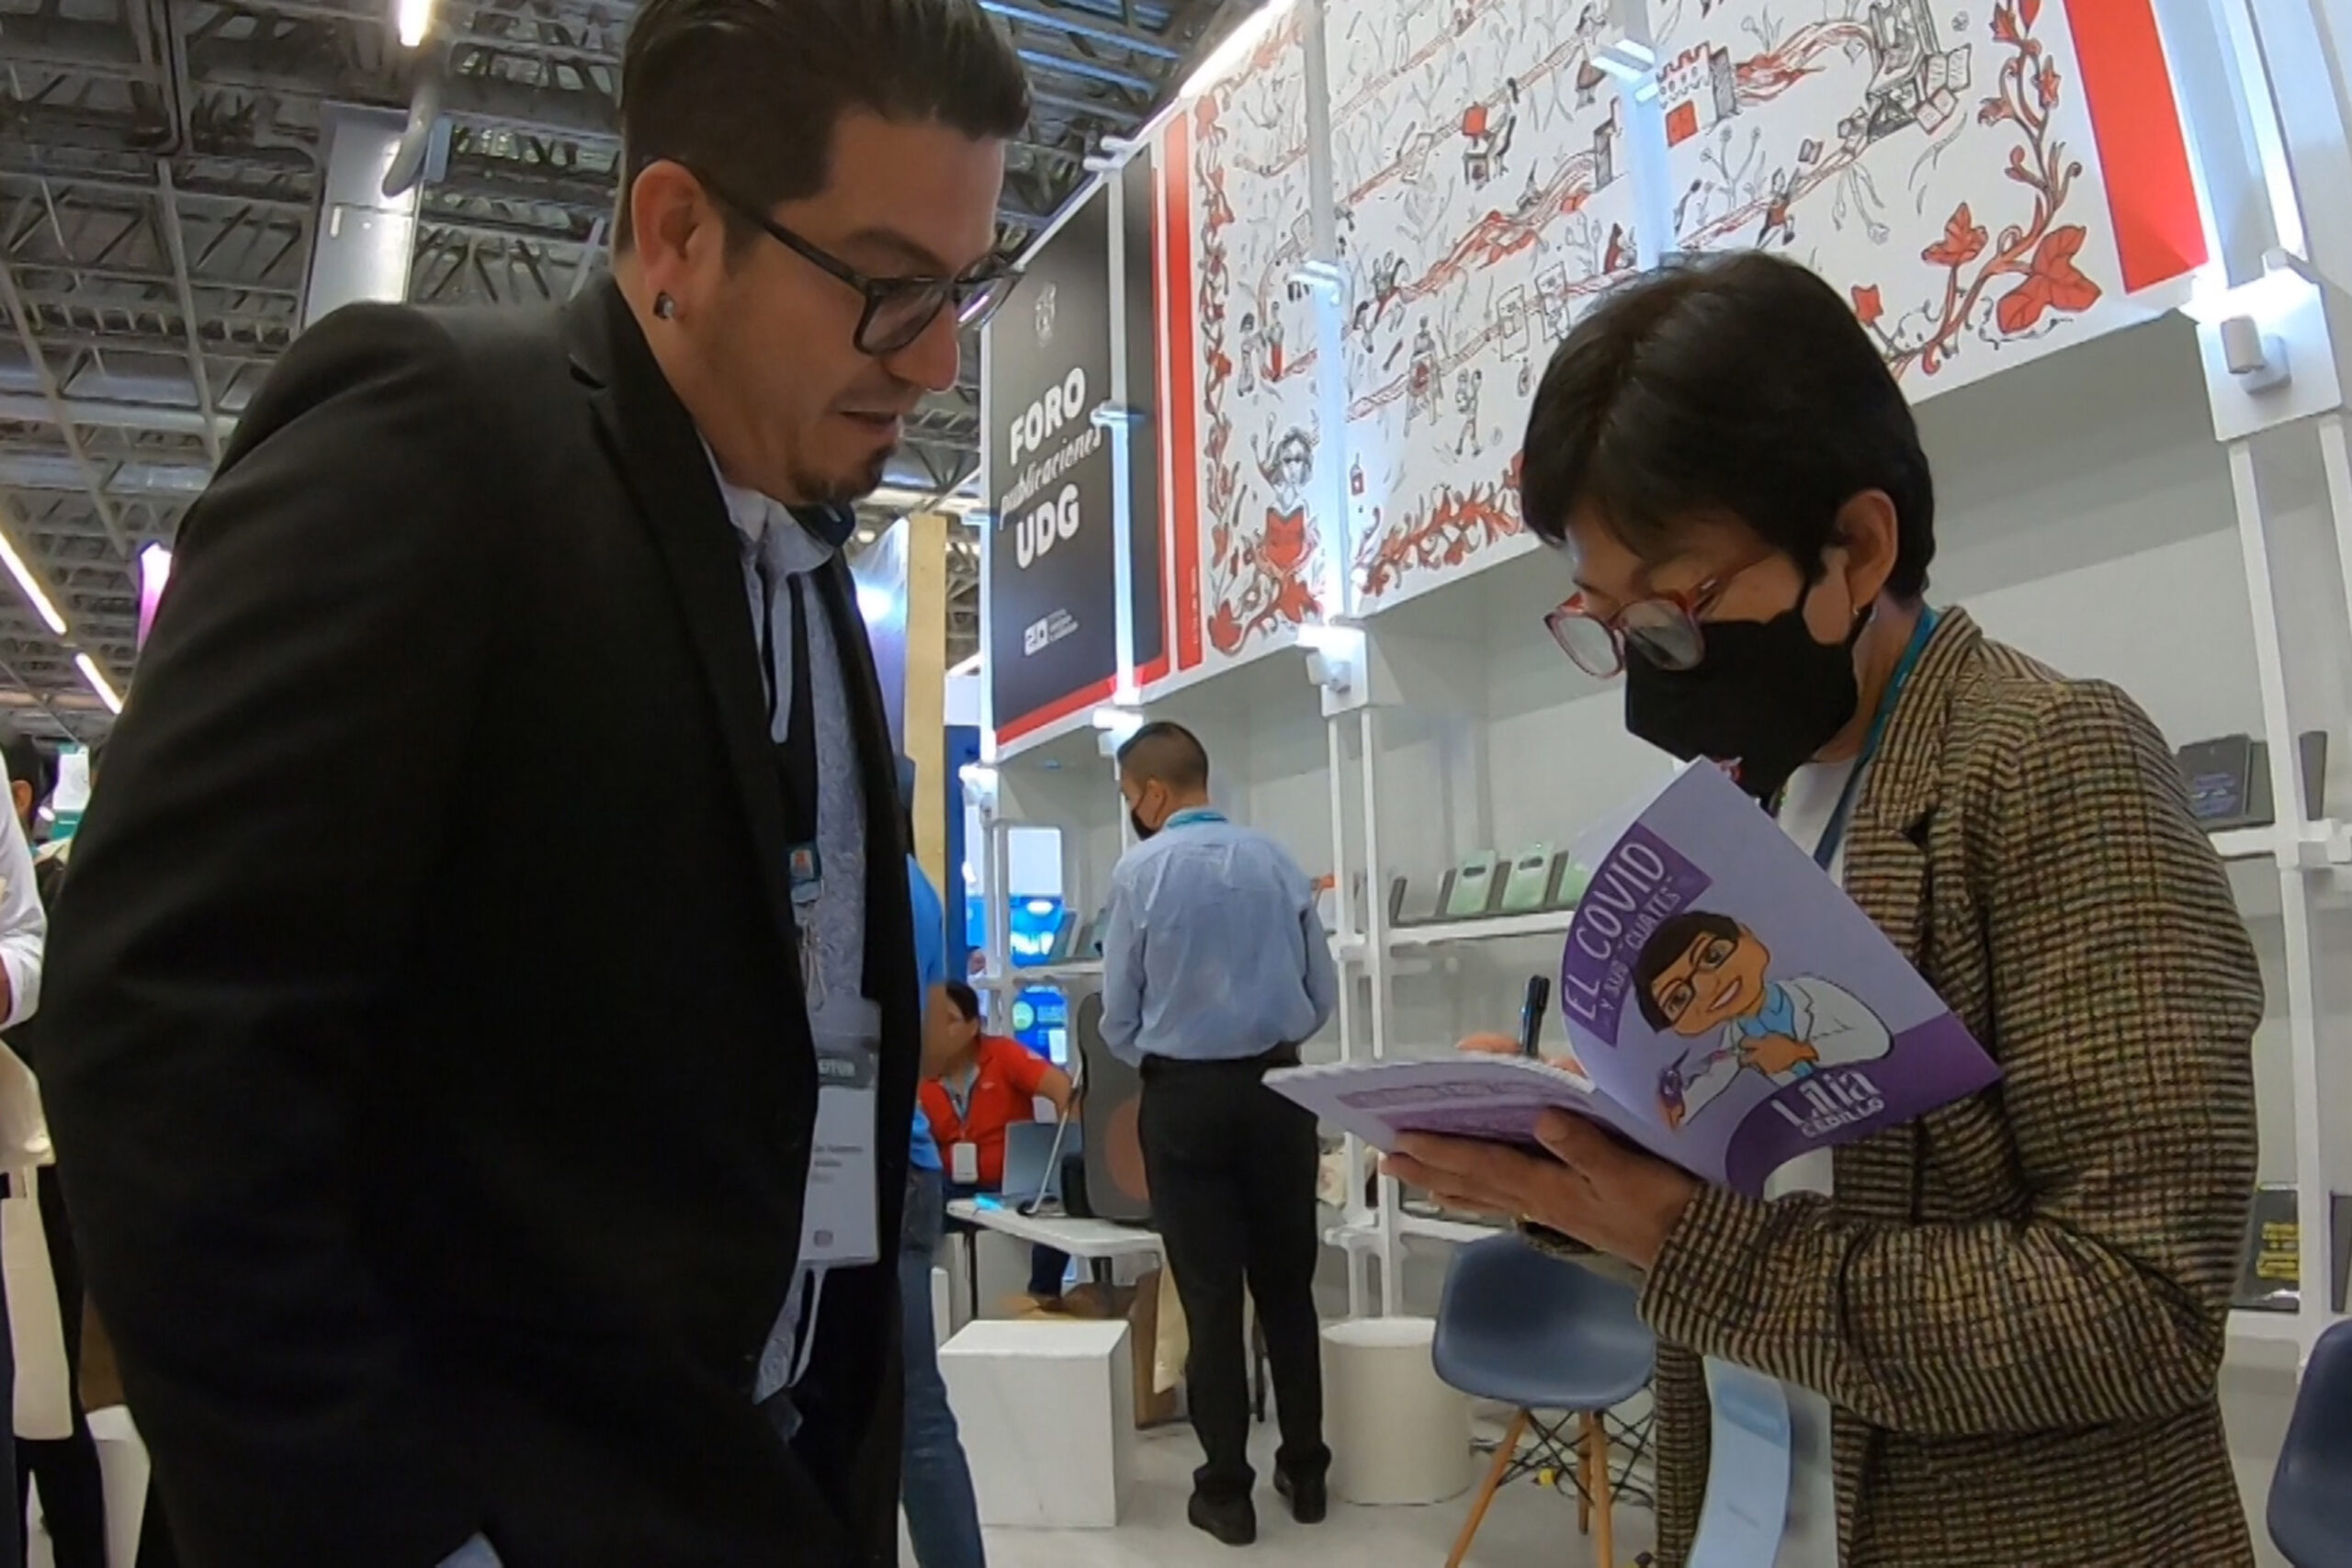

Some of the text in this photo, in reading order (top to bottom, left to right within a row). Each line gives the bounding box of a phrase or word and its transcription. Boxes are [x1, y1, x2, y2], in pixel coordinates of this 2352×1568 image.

[1011, 367, 1086, 467] FORO
[1016, 483, 1080, 569] UDG
[1564, 842, 1665, 1021] EL COVID
